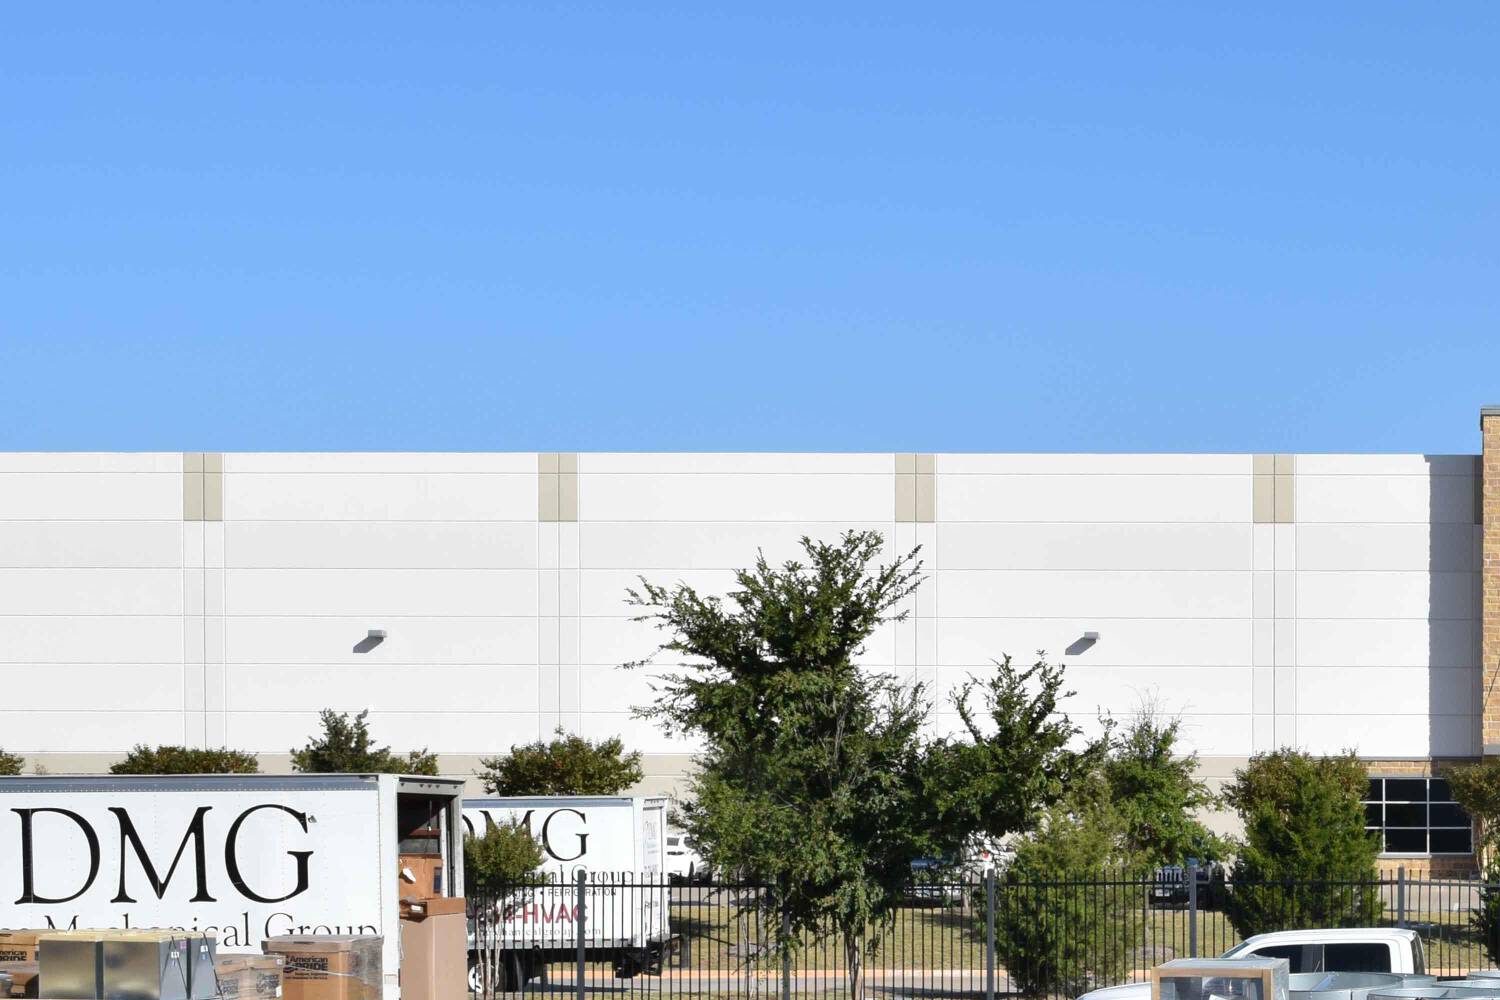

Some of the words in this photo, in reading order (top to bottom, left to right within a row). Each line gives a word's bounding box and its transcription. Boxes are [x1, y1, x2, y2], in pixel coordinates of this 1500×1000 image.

[10, 804, 314, 904] DMG
[547, 888, 617, 897] REFRIGRATION
[290, 955, 329, 963] American
